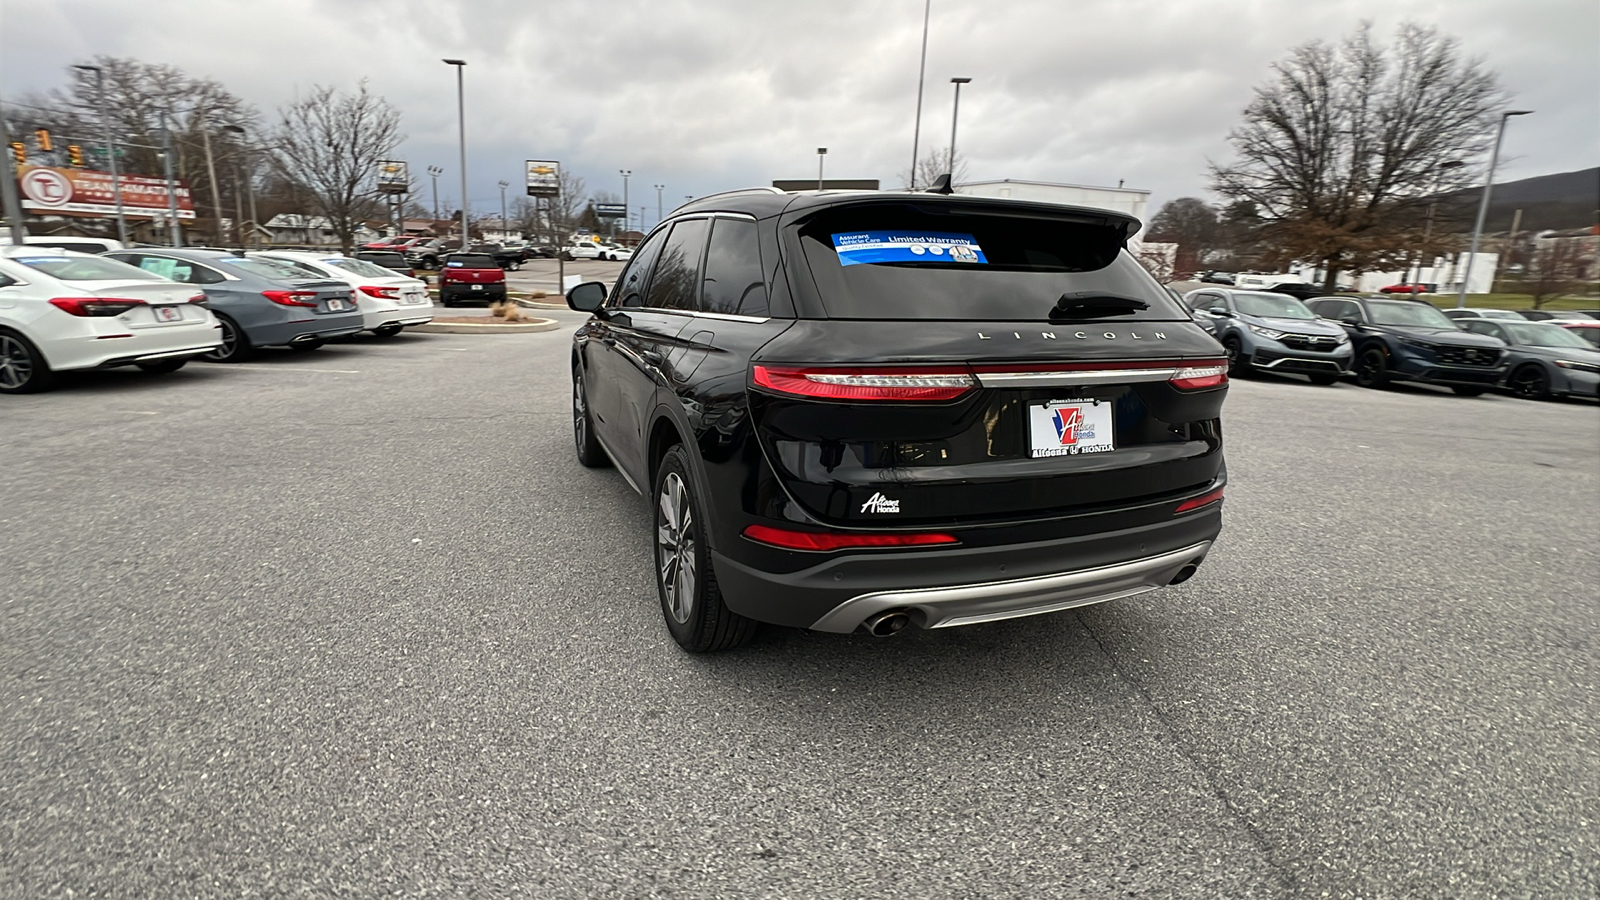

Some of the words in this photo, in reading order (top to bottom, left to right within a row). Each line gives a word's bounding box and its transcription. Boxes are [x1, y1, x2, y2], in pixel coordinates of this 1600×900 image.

[926, 237, 971, 246] Warranty
[977, 331, 1167, 340] LINCOLN
[1074, 431, 1096, 439] Honda
[1032, 446, 1068, 458] Altoona
[1081, 444, 1115, 454] HONDA
[876, 505, 900, 513] Honda
